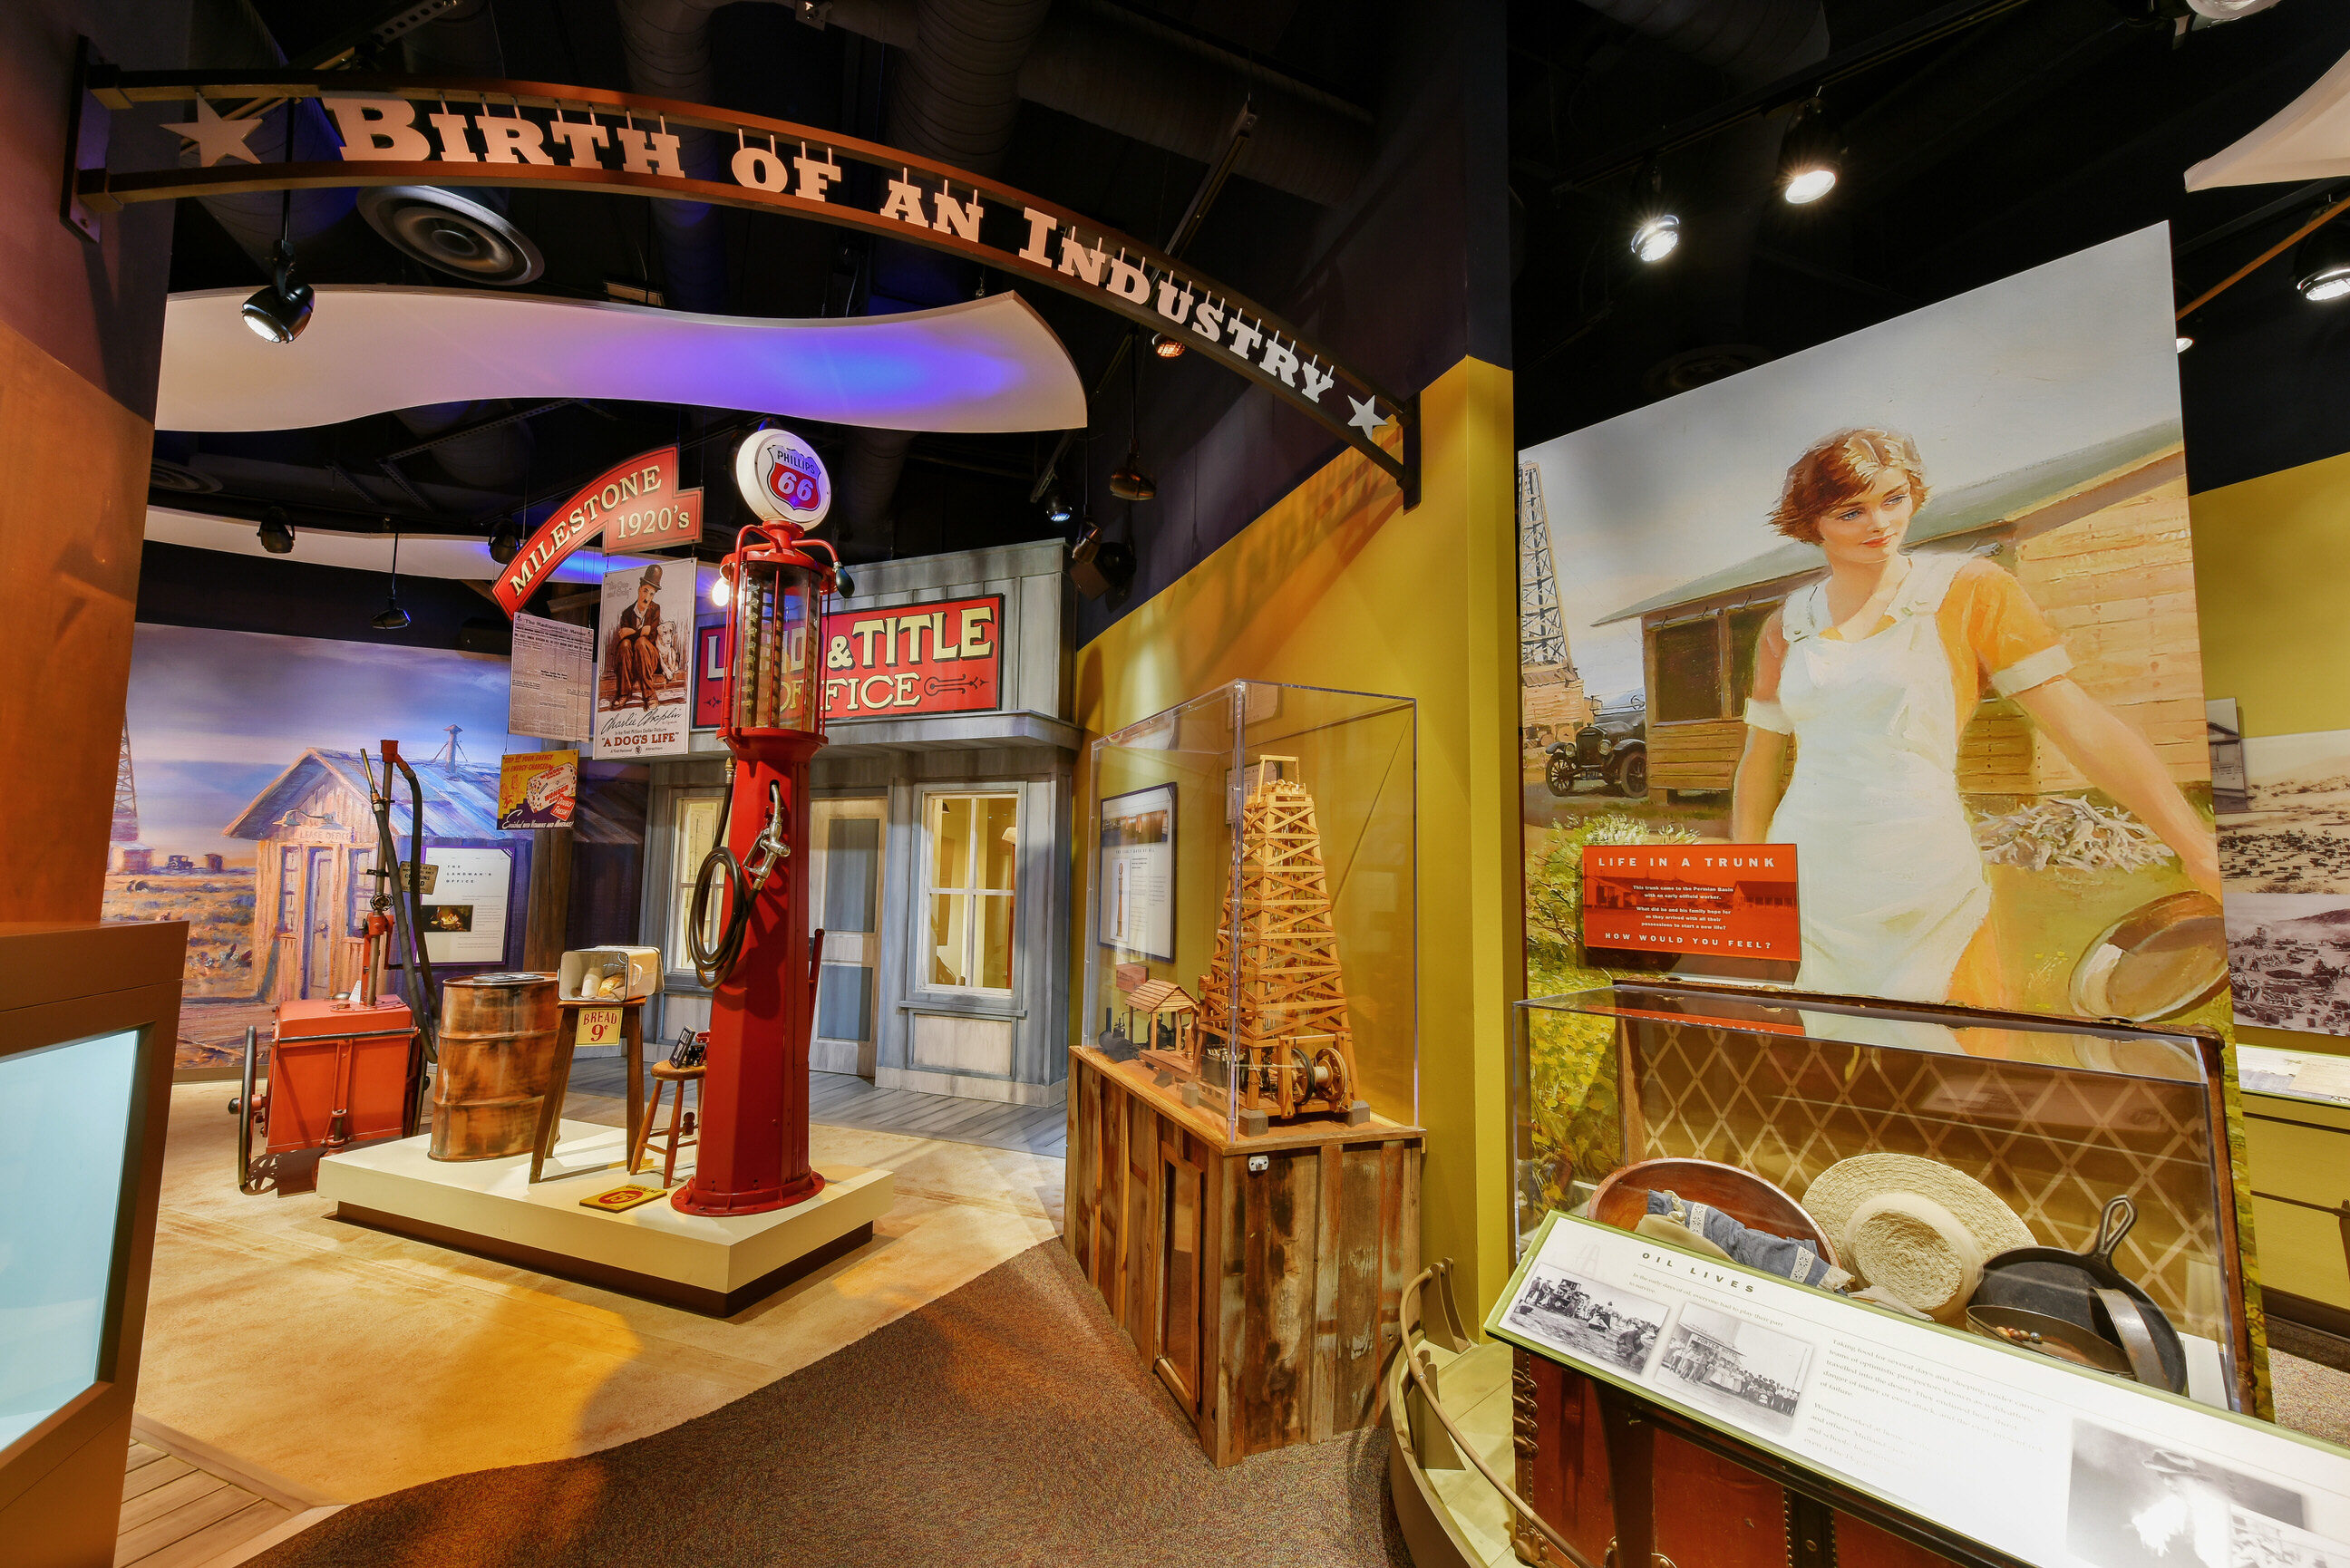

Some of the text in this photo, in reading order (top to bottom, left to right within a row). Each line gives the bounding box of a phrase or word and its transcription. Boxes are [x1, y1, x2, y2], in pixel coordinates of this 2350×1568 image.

[320, 91, 1335, 403] BIRTH OF AN INDUSTRY
[776, 450, 816, 475] PHILLIPS
[777, 470, 814, 501] 66
[509, 465, 663, 597] MILESTONE
[617, 504, 690, 539] 1920's
[827, 634, 854, 669] &
[852, 605, 995, 667] TITLE
[1598, 857, 1775, 867] LIFE IN A TRUNK
[1605, 933, 1772, 949] HOW WOULD YOU FEEL?
[583, 1011, 617, 1025] BREAD
[1642, 1253, 1754, 1293] OIL LIVES
[1648, 1278, 1662, 1288] early
[1663, 1282, 1675, 1292] days
[1693, 1292, 1719, 1304] everyone
[1719, 1300, 1732, 1309] had
[1739, 1308, 1753, 1318] play
[1770, 1318, 1784, 1326] part
[1696, 1337, 1720, 1350] PORTER
[1822, 1370, 1848, 1383] danger
[1858, 1382, 1880, 1396] injury
[1826, 1360, 1857, 1374] travelled
[1859, 1370, 1873, 1379] into
[1875, 1376, 1887, 1385] the
[1915, 1390, 1933, 1402] They
[1829, 1348, 1850, 1360] teams
[1860, 1360, 1896, 1376] optimistic
[1897, 1373, 1942, 1391] prospectors
[1833, 1339, 1856, 1352] Taking
[1875, 1353, 1887, 1361] for
[1888, 1358, 1913, 1370] several
[1915, 1366, 1934, 1377] days
[1935, 1374, 1950, 1382] and
[1952, 1380, 1986, 1396] sleeping
[1987, 1392, 2014, 1404] under
[1813, 1403, 1842, 1418] Women
